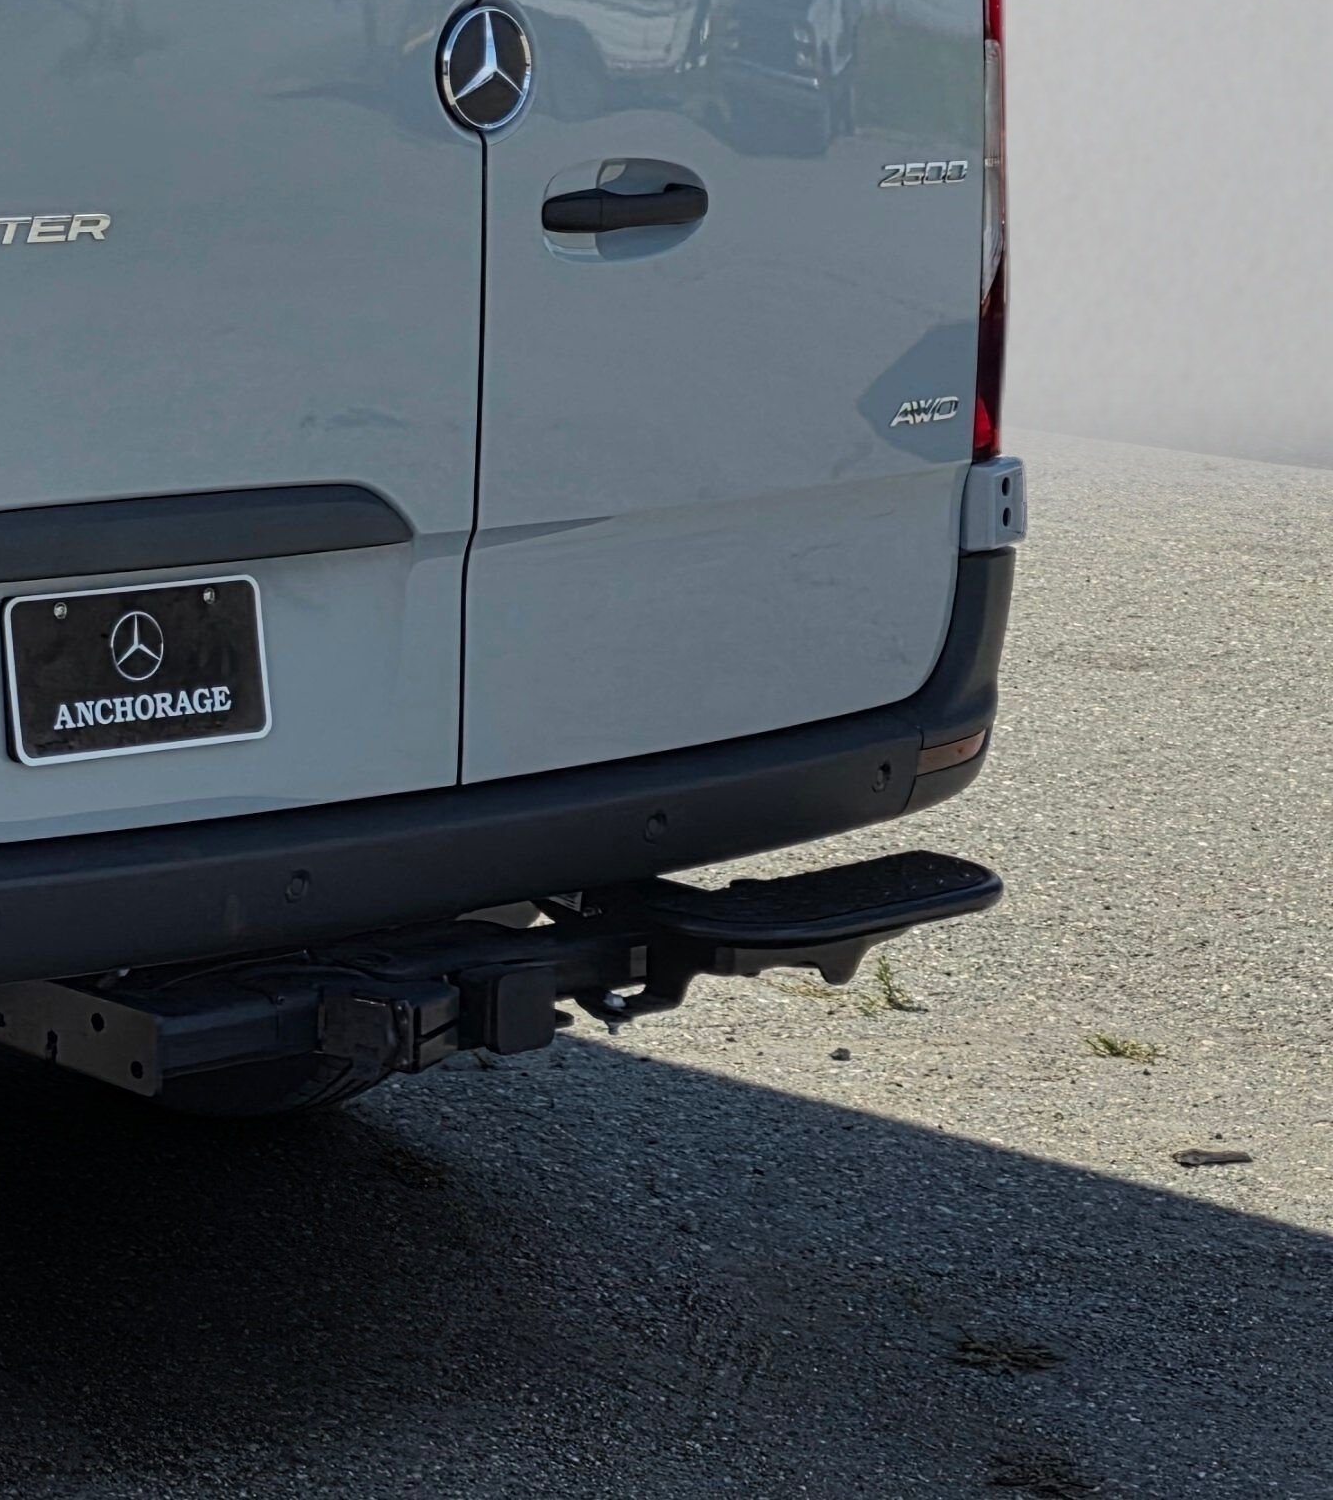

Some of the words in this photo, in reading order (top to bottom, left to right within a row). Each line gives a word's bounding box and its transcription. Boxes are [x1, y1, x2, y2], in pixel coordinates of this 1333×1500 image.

[877, 160, 969, 188] 2500
[889, 396, 960, 427] AWD
[52, 684, 233, 731] ANCHORAGE
